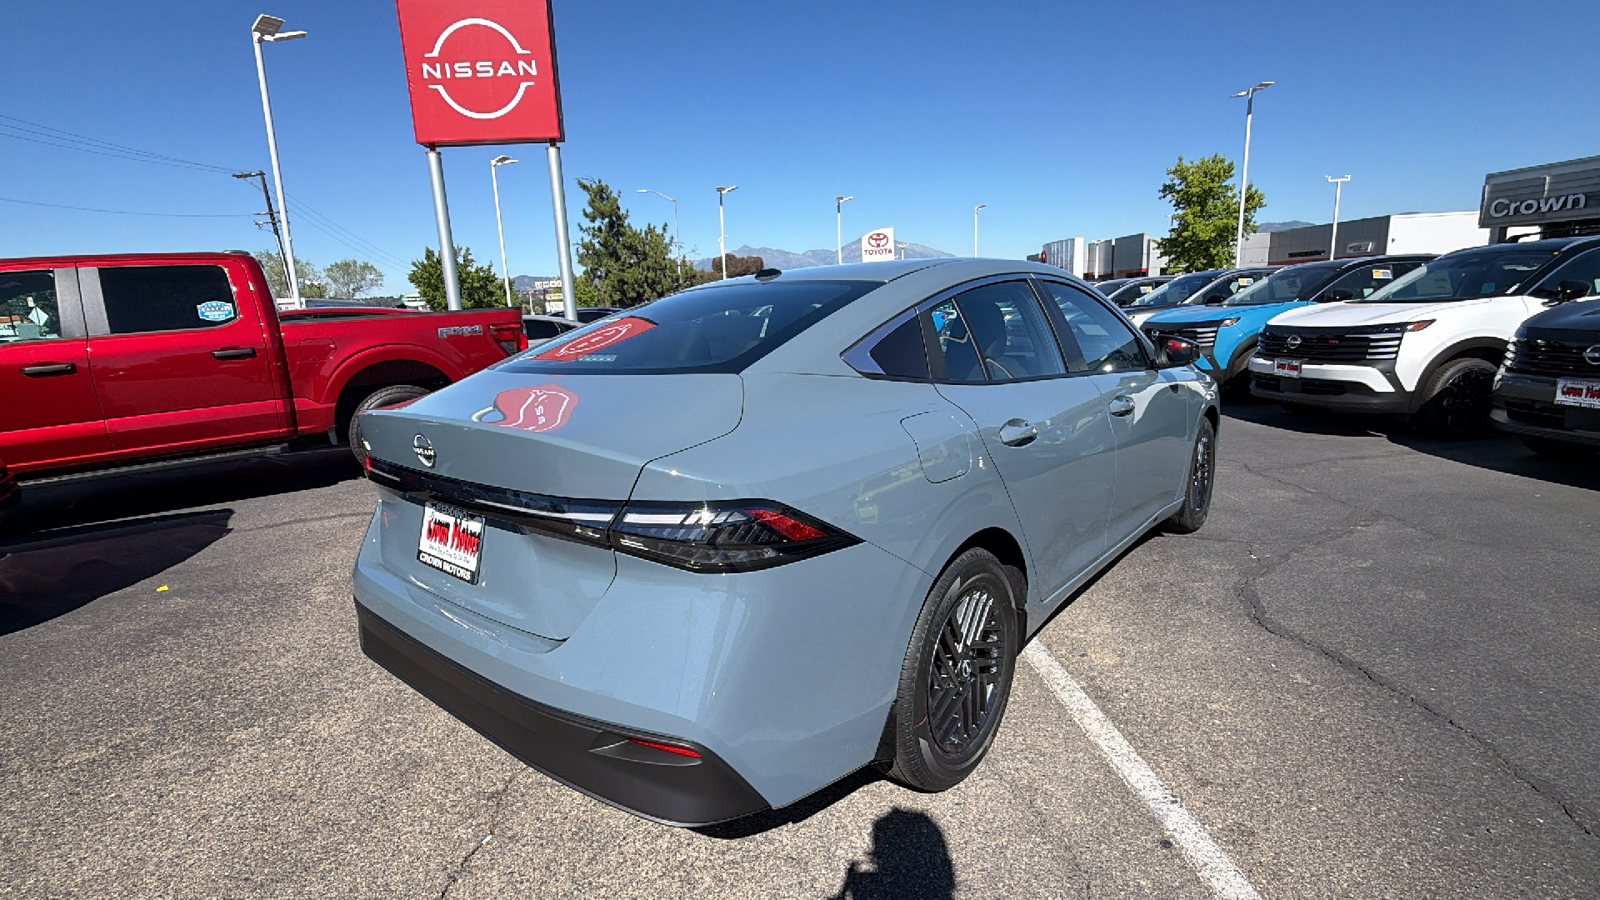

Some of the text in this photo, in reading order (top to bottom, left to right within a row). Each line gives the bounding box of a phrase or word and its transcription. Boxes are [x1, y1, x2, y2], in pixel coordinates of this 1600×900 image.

[422, 60, 537, 79] NISSAN
[1490, 193, 1586, 218] Crown
[438, 325, 483, 338] FX4
[427, 517, 450, 547] Crown
[450, 519, 479, 558] Motors
[420, 553, 443, 569] CROWN
[443, 561, 471, 580] MOTORS
